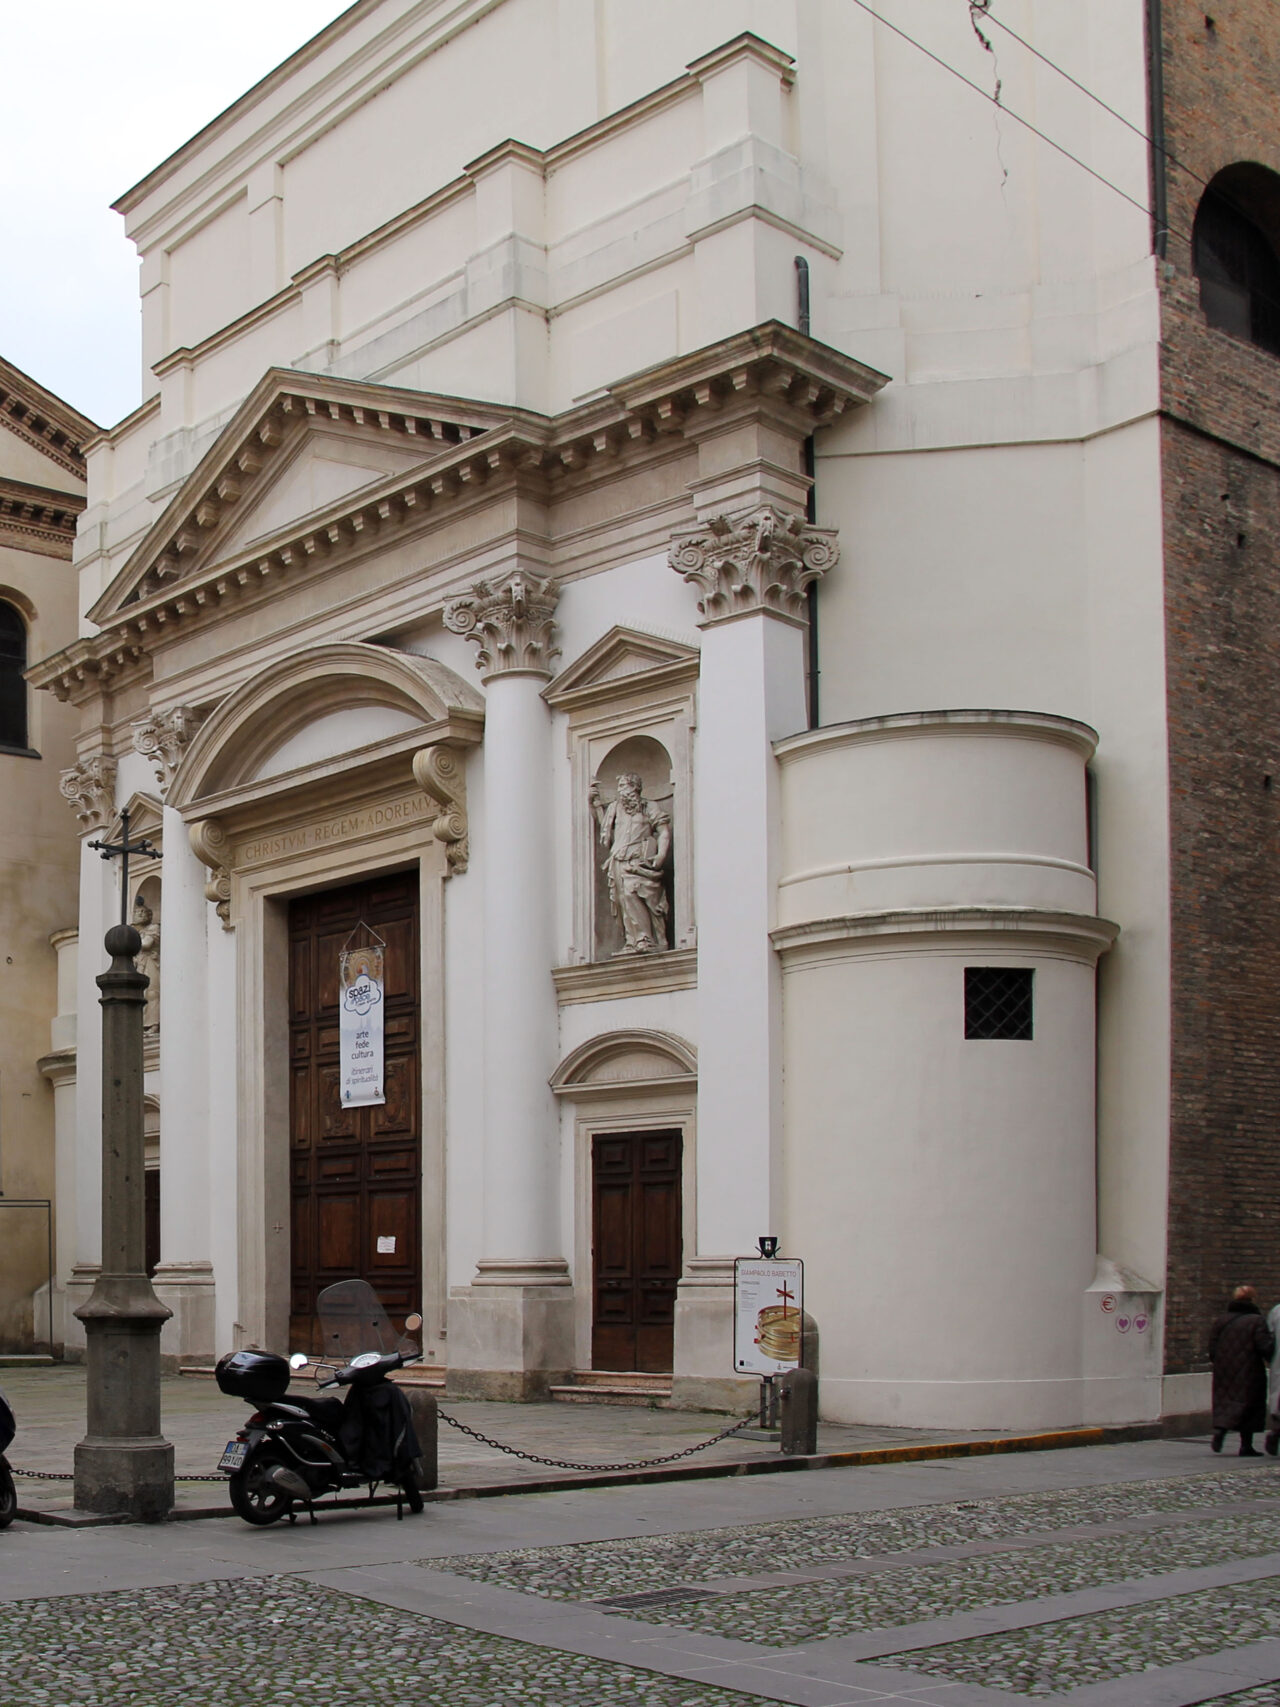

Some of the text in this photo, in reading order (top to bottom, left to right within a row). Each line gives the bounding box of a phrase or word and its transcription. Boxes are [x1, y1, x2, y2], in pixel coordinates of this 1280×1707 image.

[245, 831, 307, 861] CHRISTVM
[314, 817, 360, 842] REGEM
[348, 981, 371, 1000] spazi
[355, 1030, 369, 1040] arte
[355, 1039, 370, 1050] fede
[351, 1050, 374, 1060] cultura
